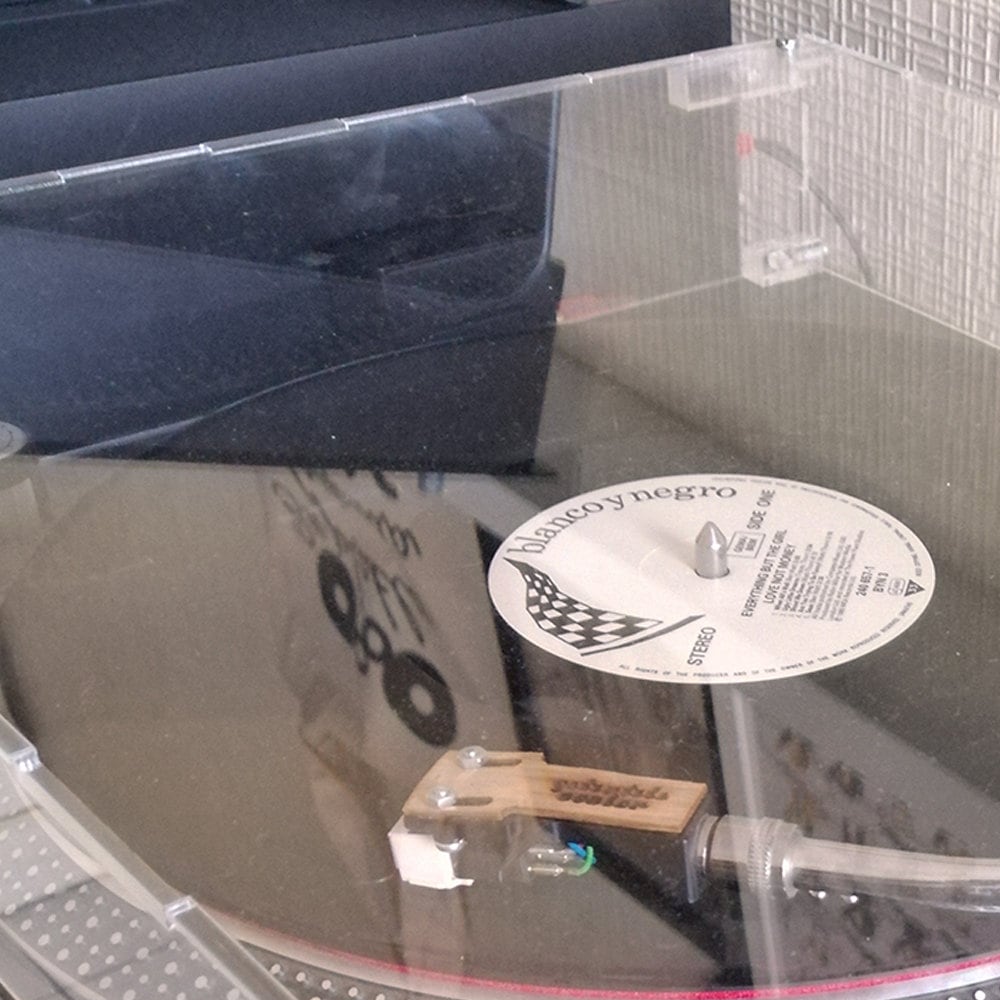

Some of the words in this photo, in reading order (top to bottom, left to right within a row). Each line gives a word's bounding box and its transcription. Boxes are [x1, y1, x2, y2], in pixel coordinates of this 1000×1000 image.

[756, 489, 776, 508] ONE
[506, 501, 604, 554] blanco
[605, 494, 625, 511] y
[630, 485, 738, 501] negro
[746, 510, 767, 530] SIDE
[766, 544, 781, 558] THE
[777, 543, 797, 570] MONEY
[760, 558, 774, 573] BUT
[772, 569, 786, 583] NOT
[741, 572, 769, 617] EVERYTHING
[763, 582, 781, 604] LOVE
[687, 626, 717, 666] STEREO
